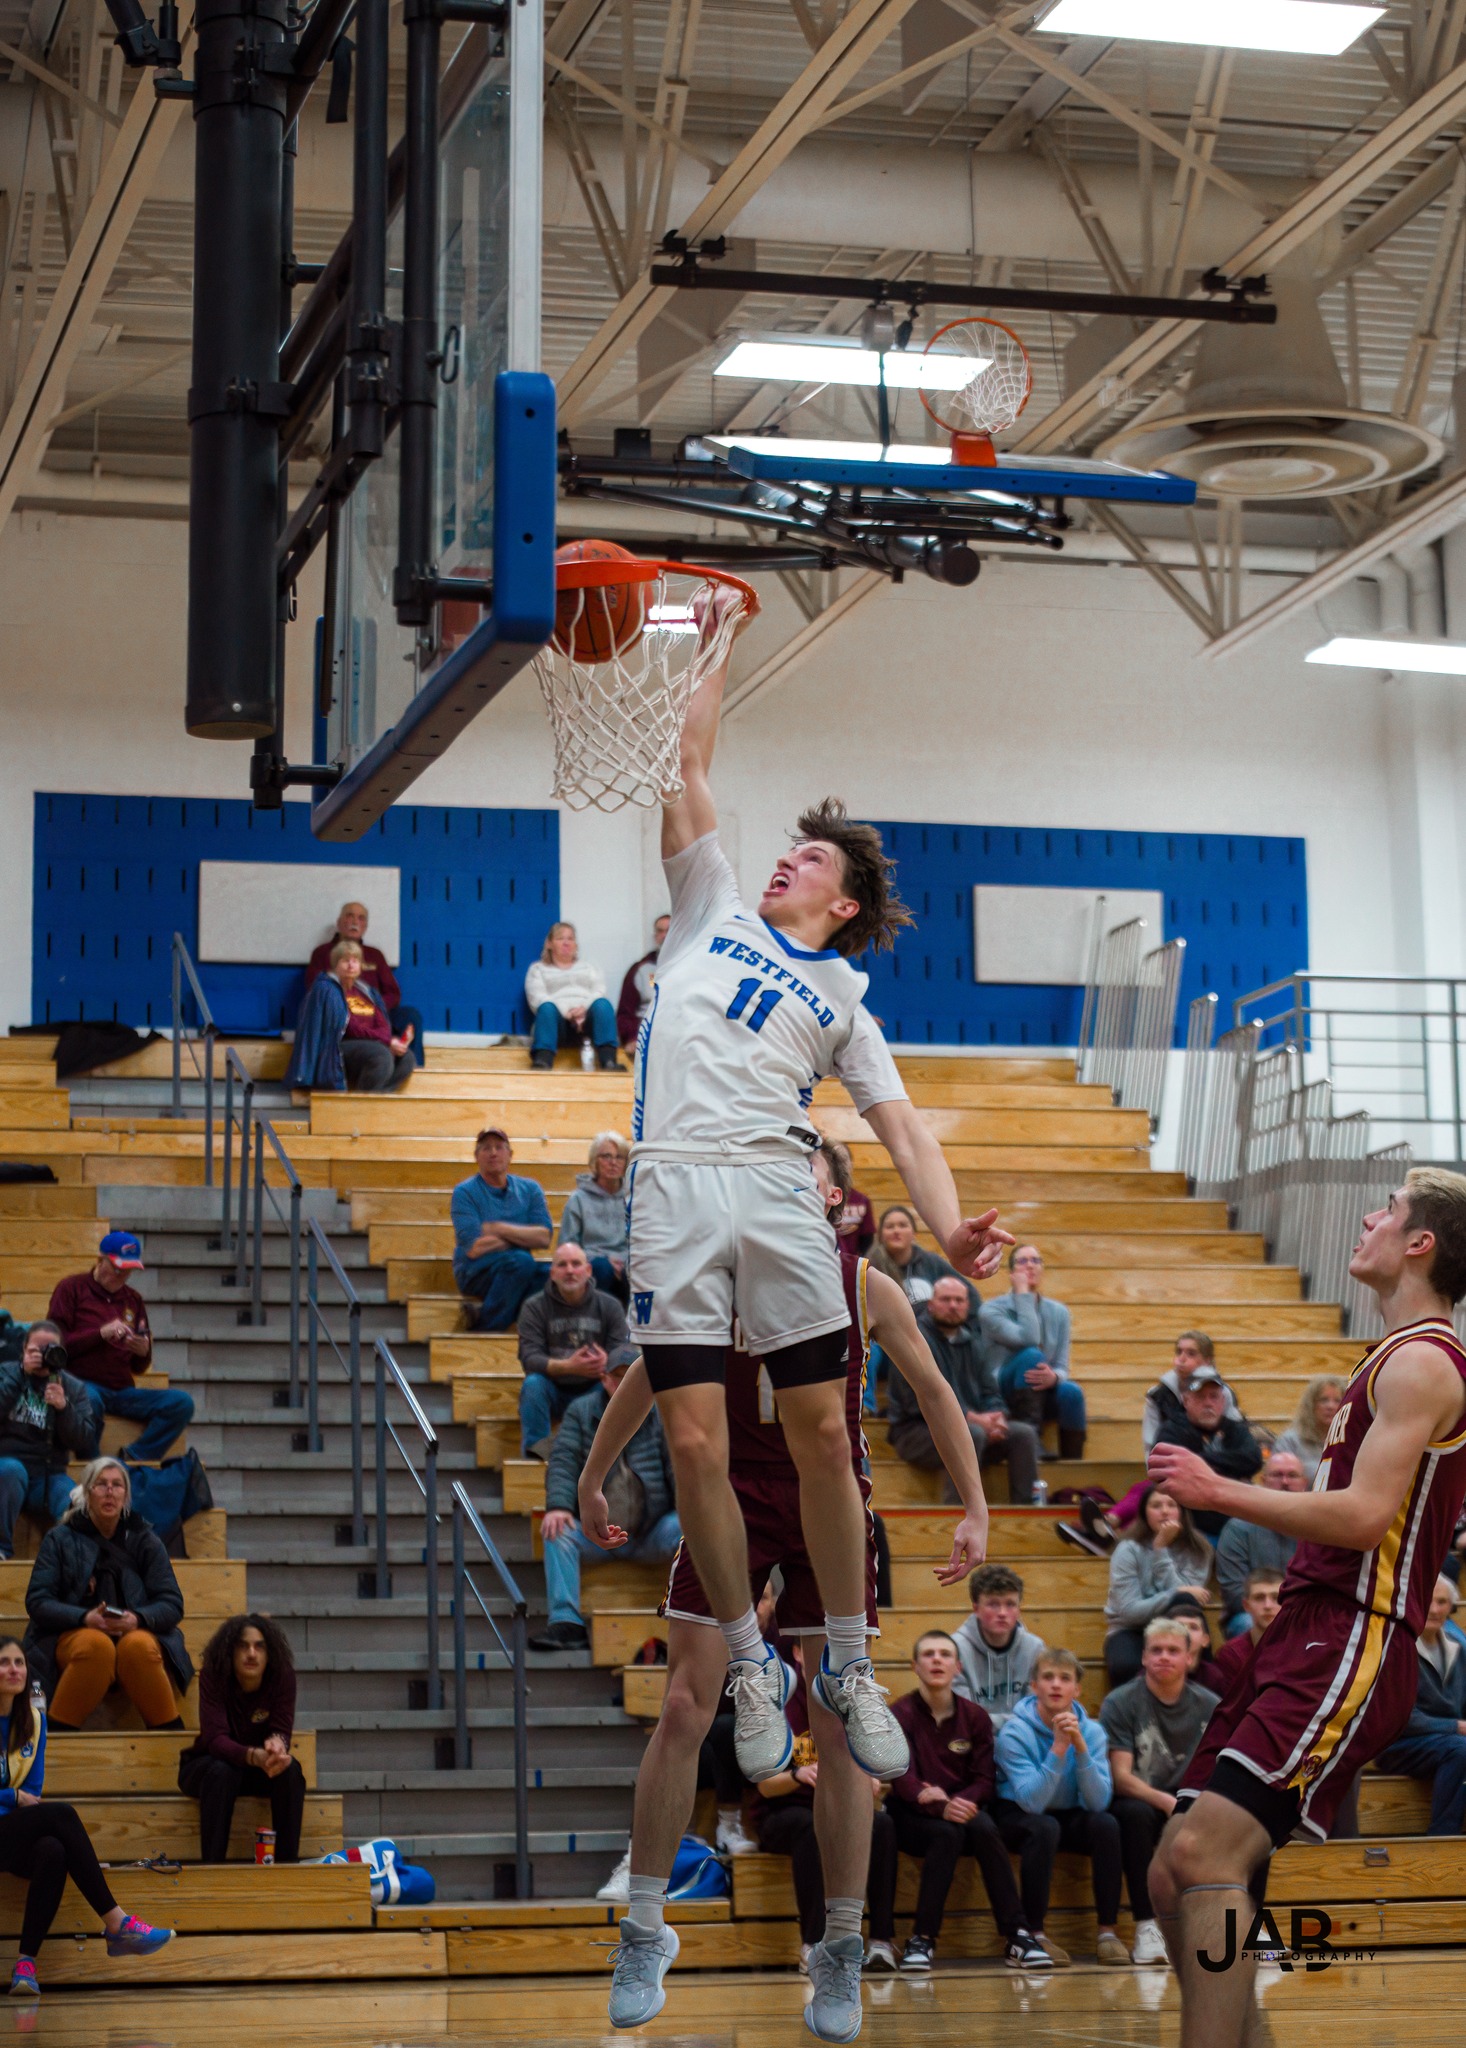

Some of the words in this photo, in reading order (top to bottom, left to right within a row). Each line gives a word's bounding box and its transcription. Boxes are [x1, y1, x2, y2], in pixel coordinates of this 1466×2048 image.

[708, 936, 835, 1029] WESTFIELD
[726, 978, 784, 1034] 11
[633, 1291, 654, 1325] W
